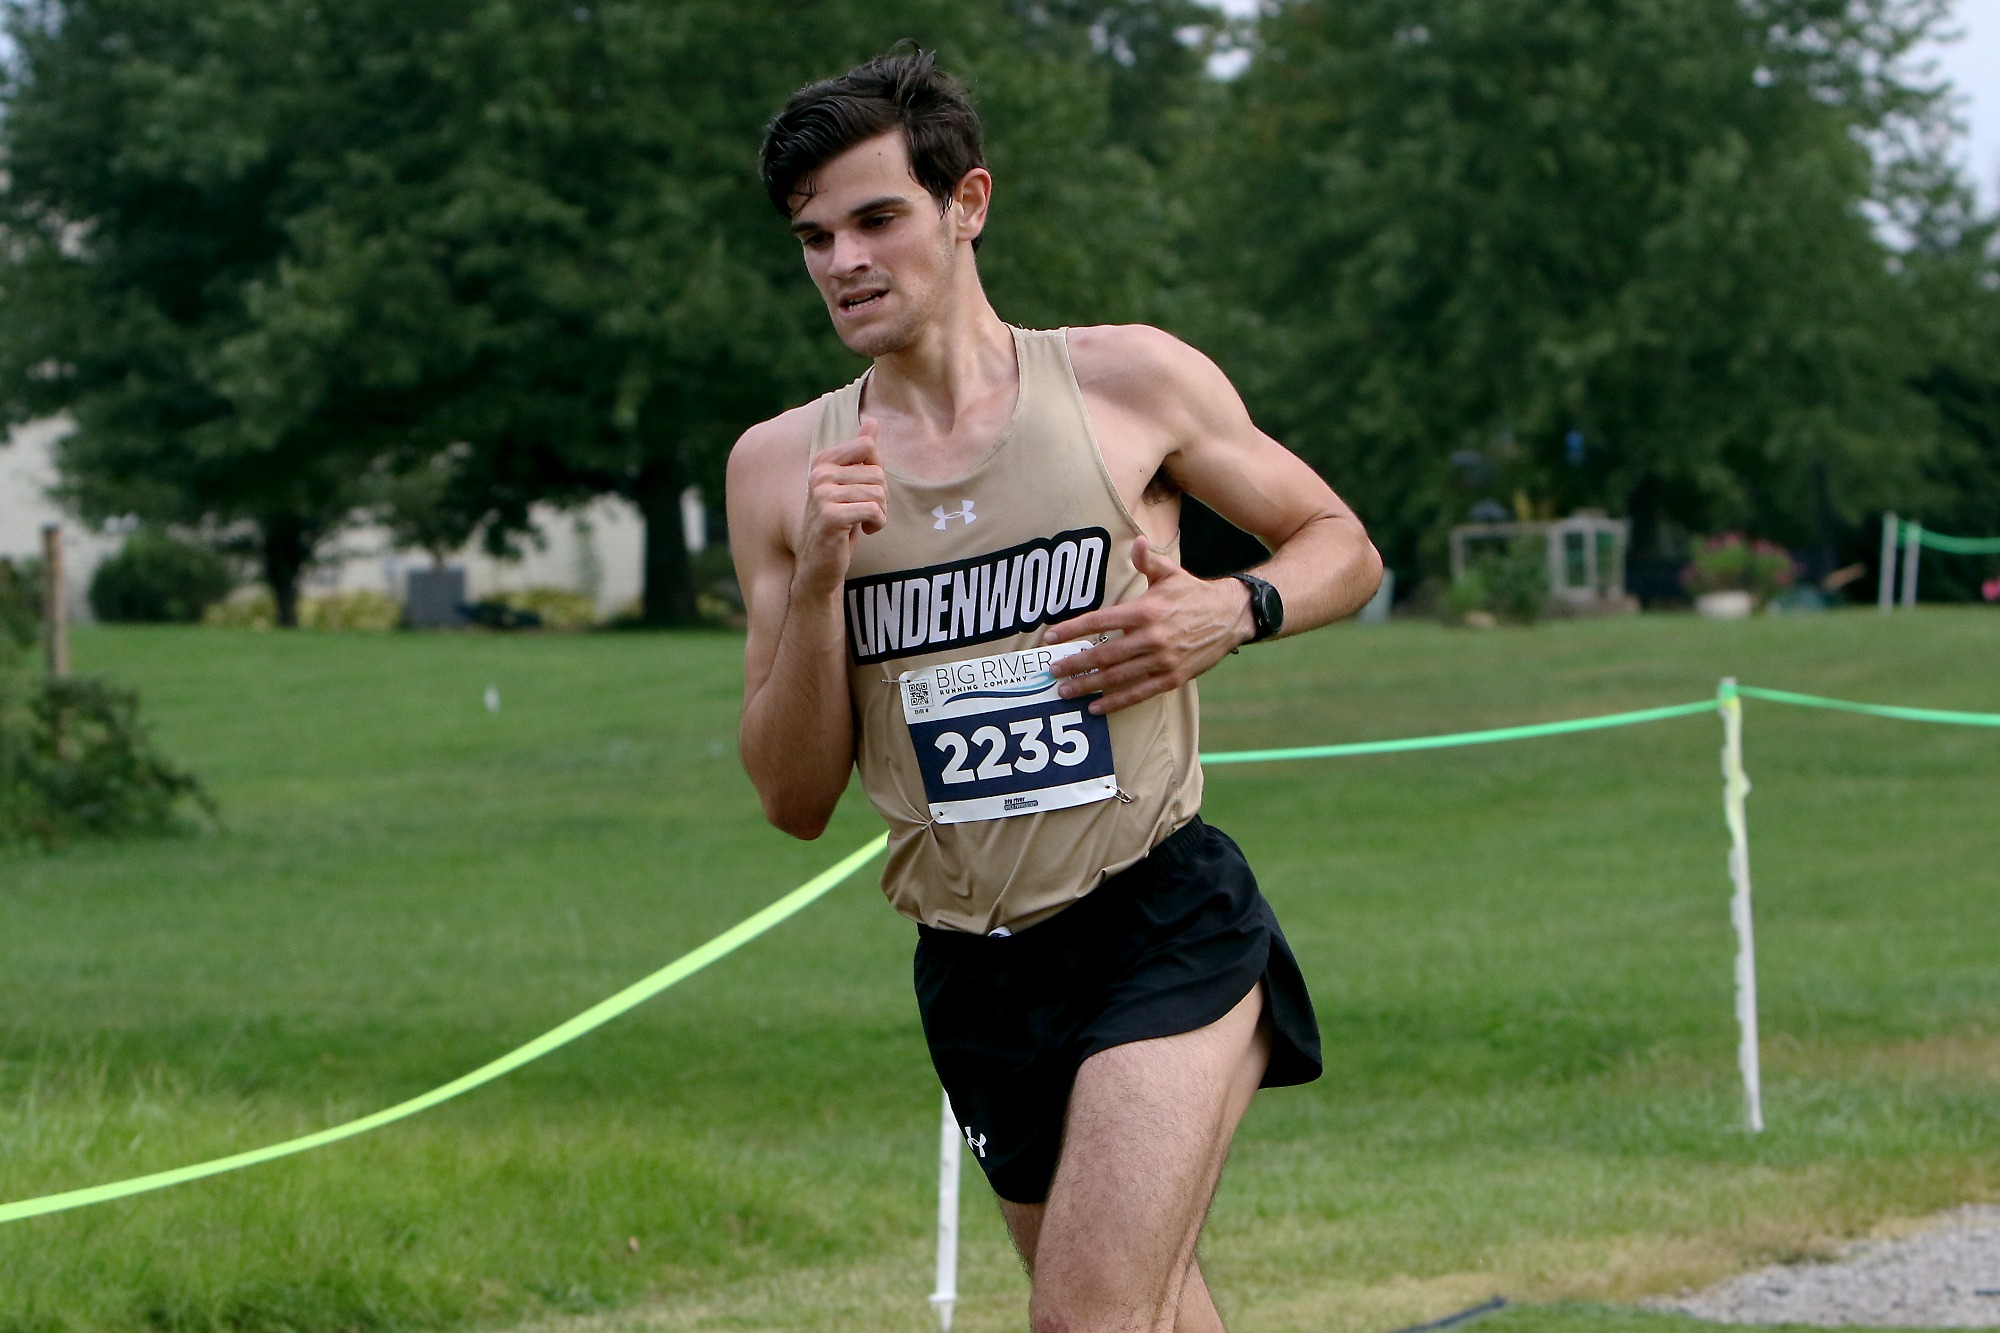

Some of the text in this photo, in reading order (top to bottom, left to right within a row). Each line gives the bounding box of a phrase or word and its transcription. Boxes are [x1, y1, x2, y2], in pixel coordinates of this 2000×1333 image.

[848, 536, 1104, 657] LINDENWOOD
[936, 664, 975, 689] BIG
[981, 650, 1052, 680] RIVER
[940, 676, 1028, 696] RUNNING COMPANY
[935, 711, 1090, 785] 2235
